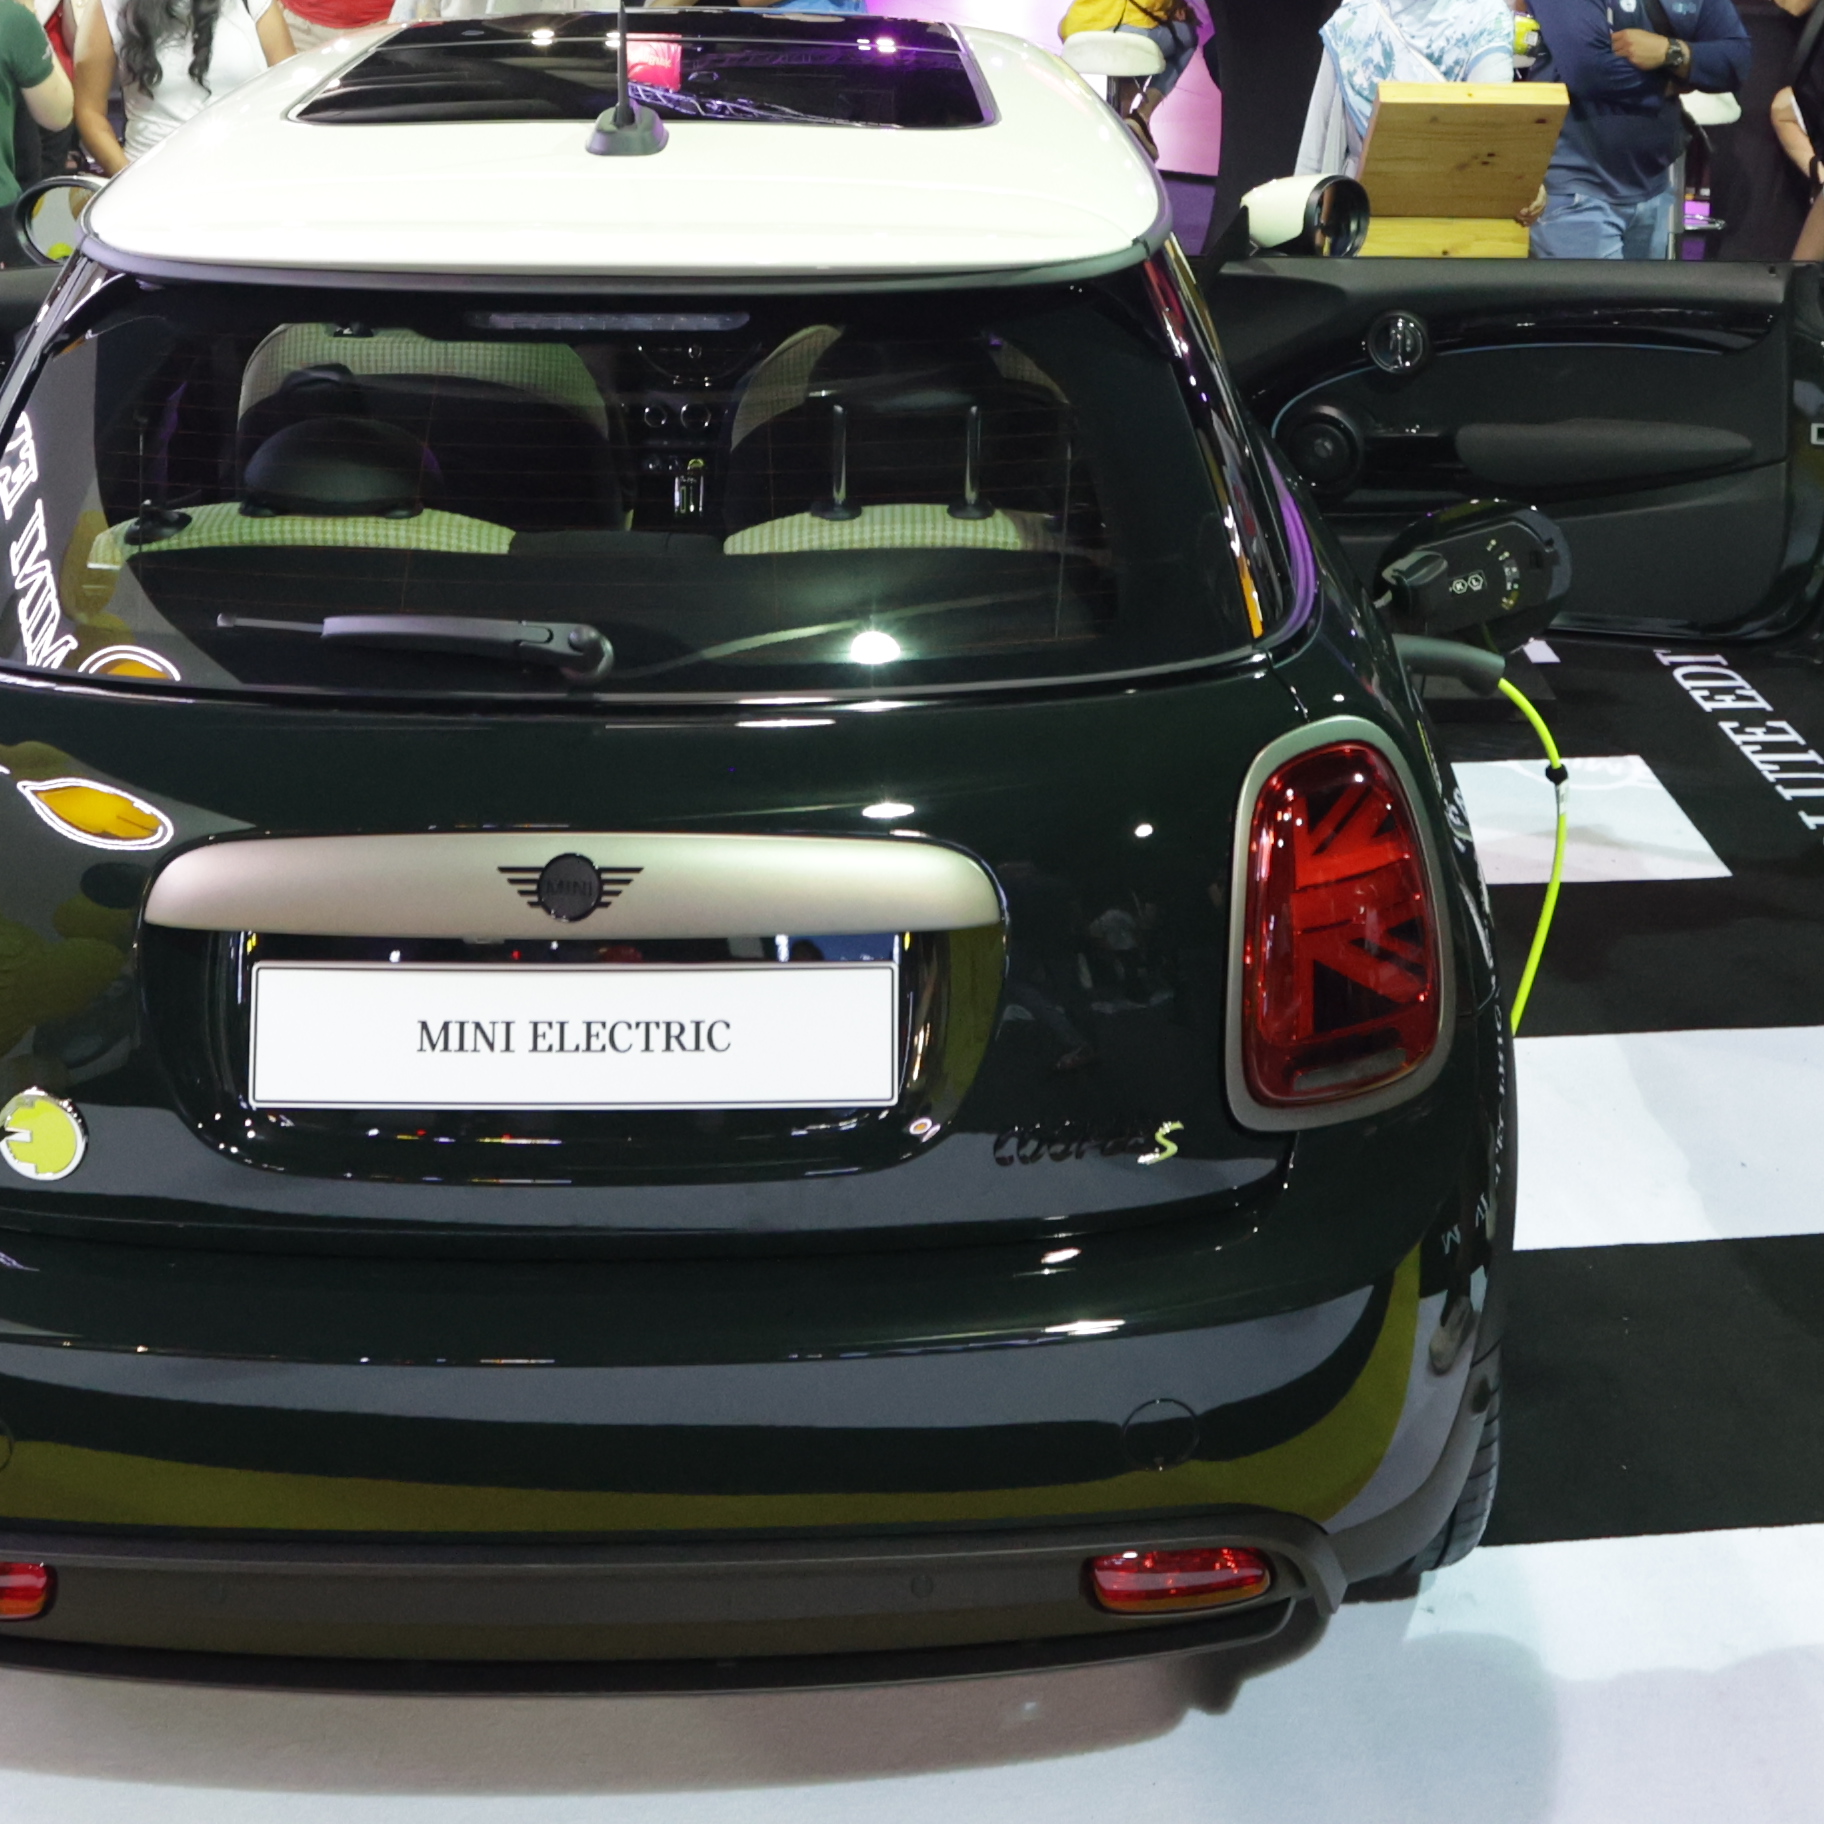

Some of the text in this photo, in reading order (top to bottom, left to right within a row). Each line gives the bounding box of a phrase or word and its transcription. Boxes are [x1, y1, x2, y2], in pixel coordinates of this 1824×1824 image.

[1656, 649, 1773, 713] EDI
[546, 879, 593, 897] MINI
[416, 1019, 733, 1054] MINI ELECTRIC
[1137, 1121, 1186, 1166] S
